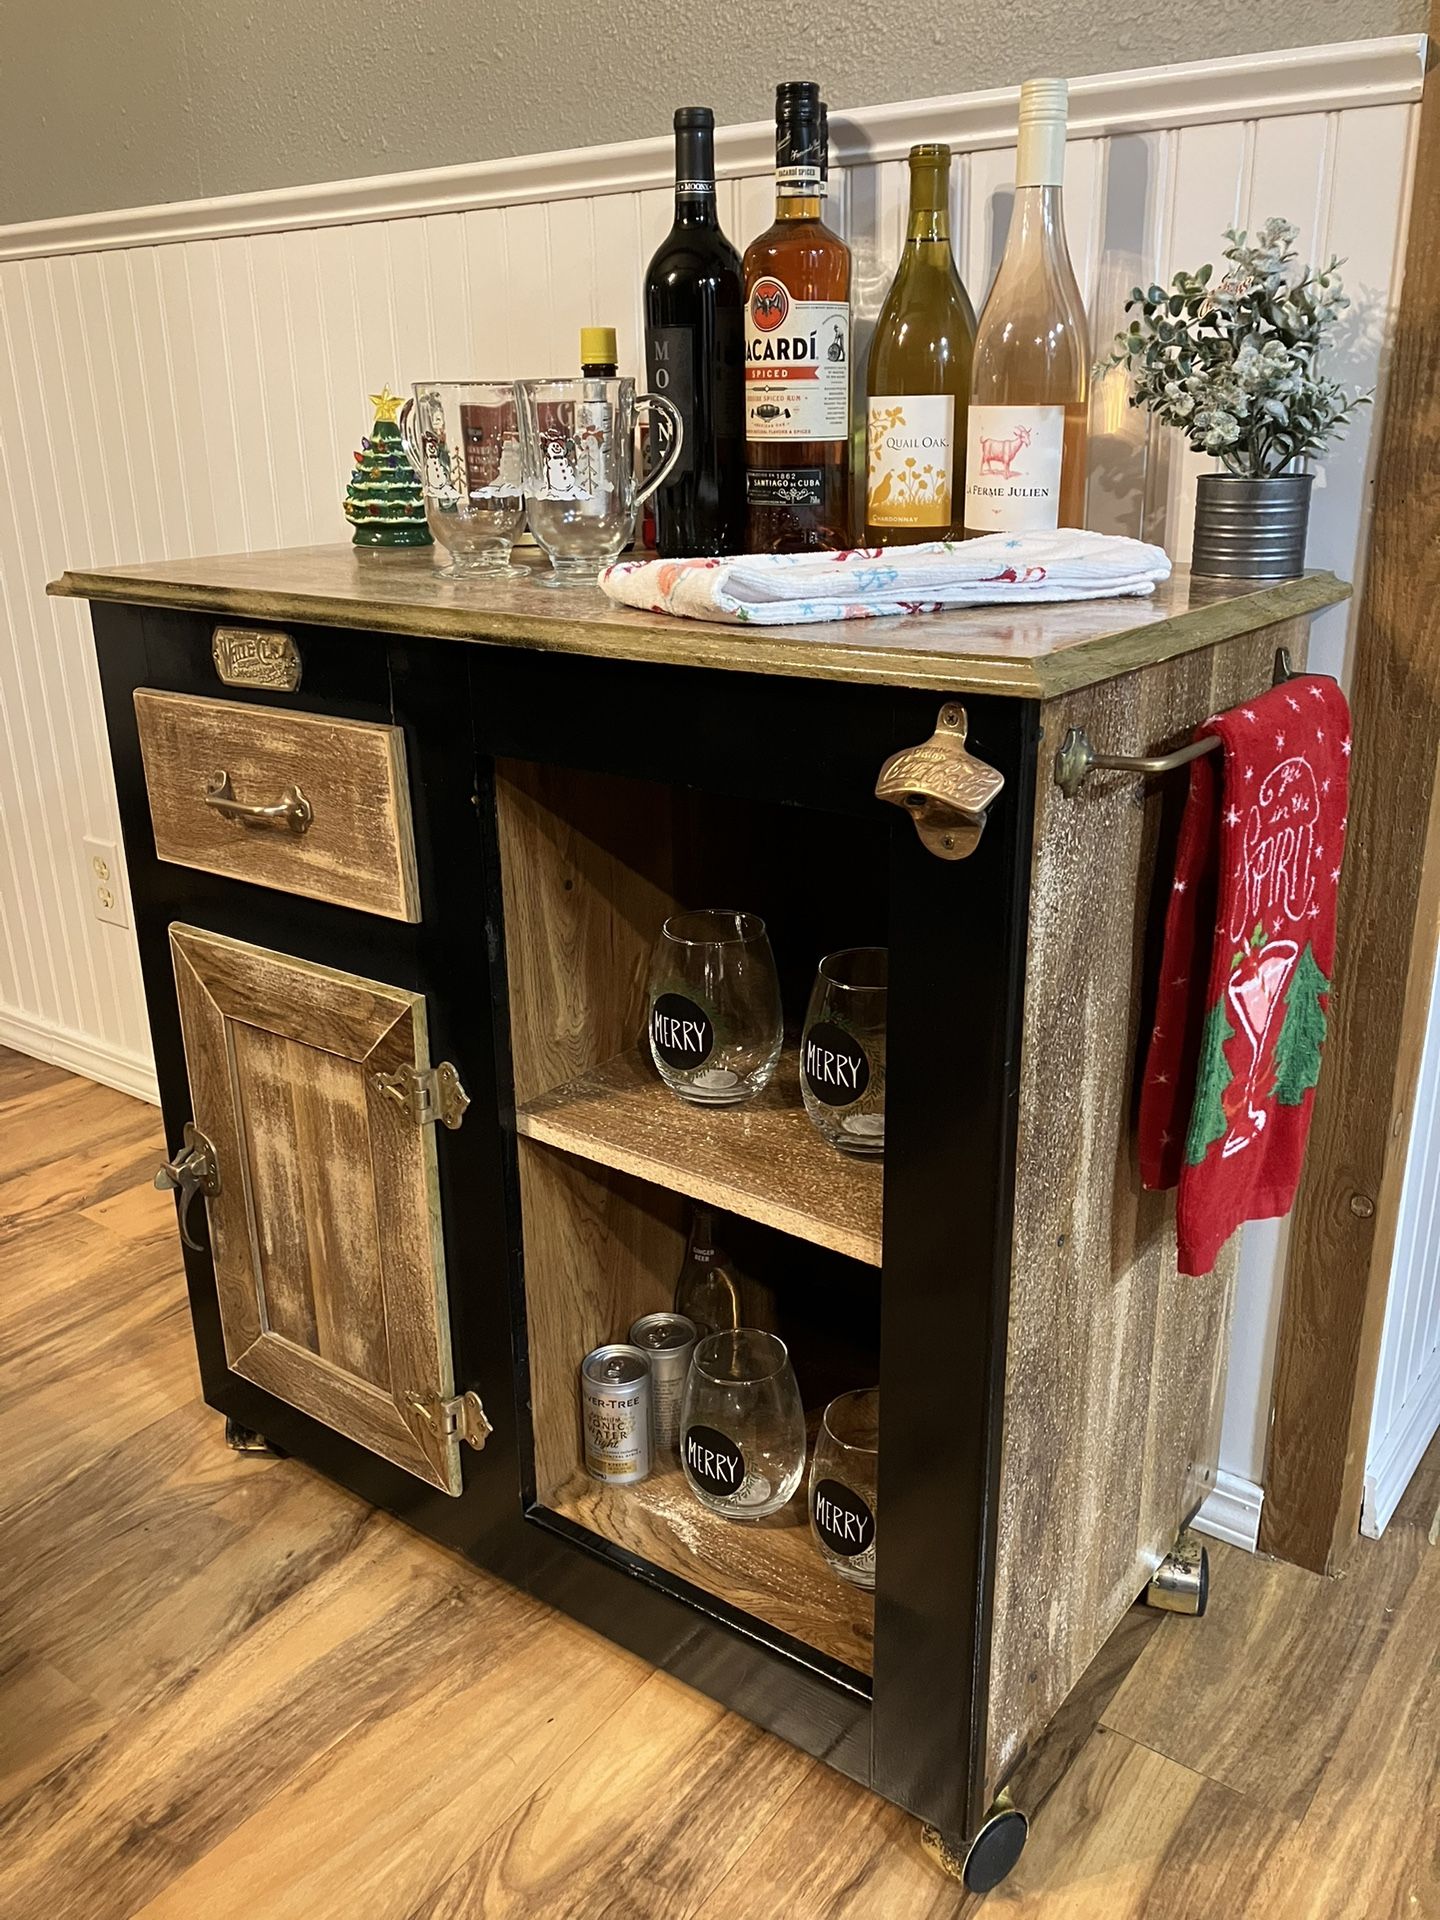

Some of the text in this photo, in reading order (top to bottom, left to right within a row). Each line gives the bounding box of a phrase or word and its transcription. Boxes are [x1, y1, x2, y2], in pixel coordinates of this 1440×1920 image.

[746, 330, 817, 361] ACARDÍ
[751, 370, 788, 378] SPICED
[886, 437, 920, 451] QUAIL
[753, 479, 789, 487] SANTIAGO
[797, 479, 821, 487] CUBA
[776, 472, 796, 480] 1862
[972, 484, 1005, 497] FERME
[1007, 486, 1050, 497] JULIEN
[872, 514, 920, 522] CHARDONNAY
[653, 1010, 706, 1053] MERRY
[806, 1040, 862, 1089] MERRY
[688, 1436, 739, 1484] MERRY
[816, 1491, 868, 1544] MERRY
